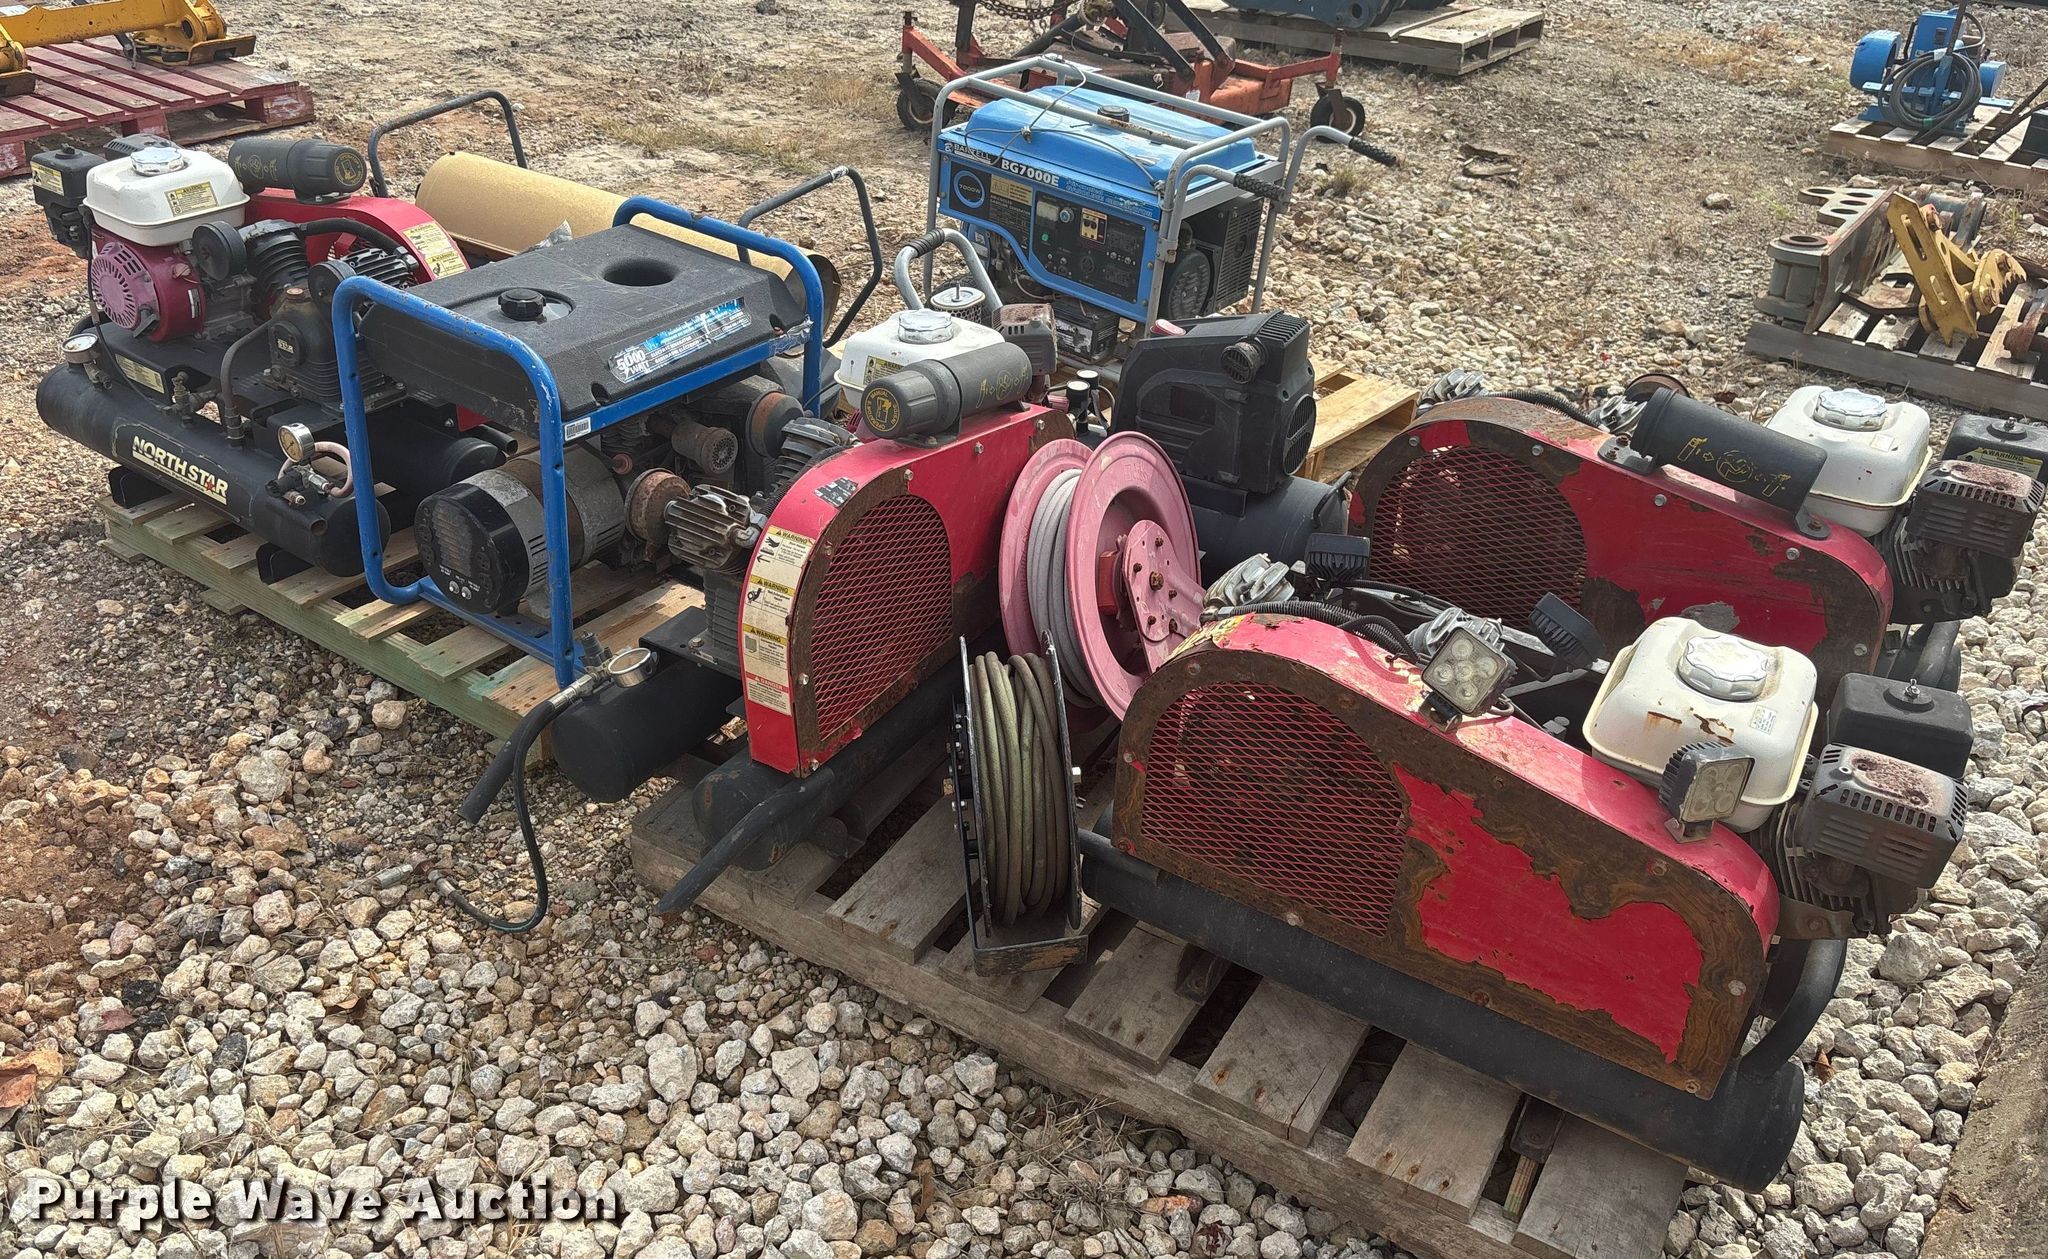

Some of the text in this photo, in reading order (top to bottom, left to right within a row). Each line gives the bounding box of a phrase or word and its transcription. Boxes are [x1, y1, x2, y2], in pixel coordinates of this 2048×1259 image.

[1001, 159, 1060, 187] BG7000E
[958, 183, 981, 194] 7000W
[616, 349, 646, 371] 5000
[630, 360, 650, 376] WATT
[782, 531, 808, 544] WARNING
[763, 580, 789, 594] WARNING
[756, 630, 782, 643] WARNING
